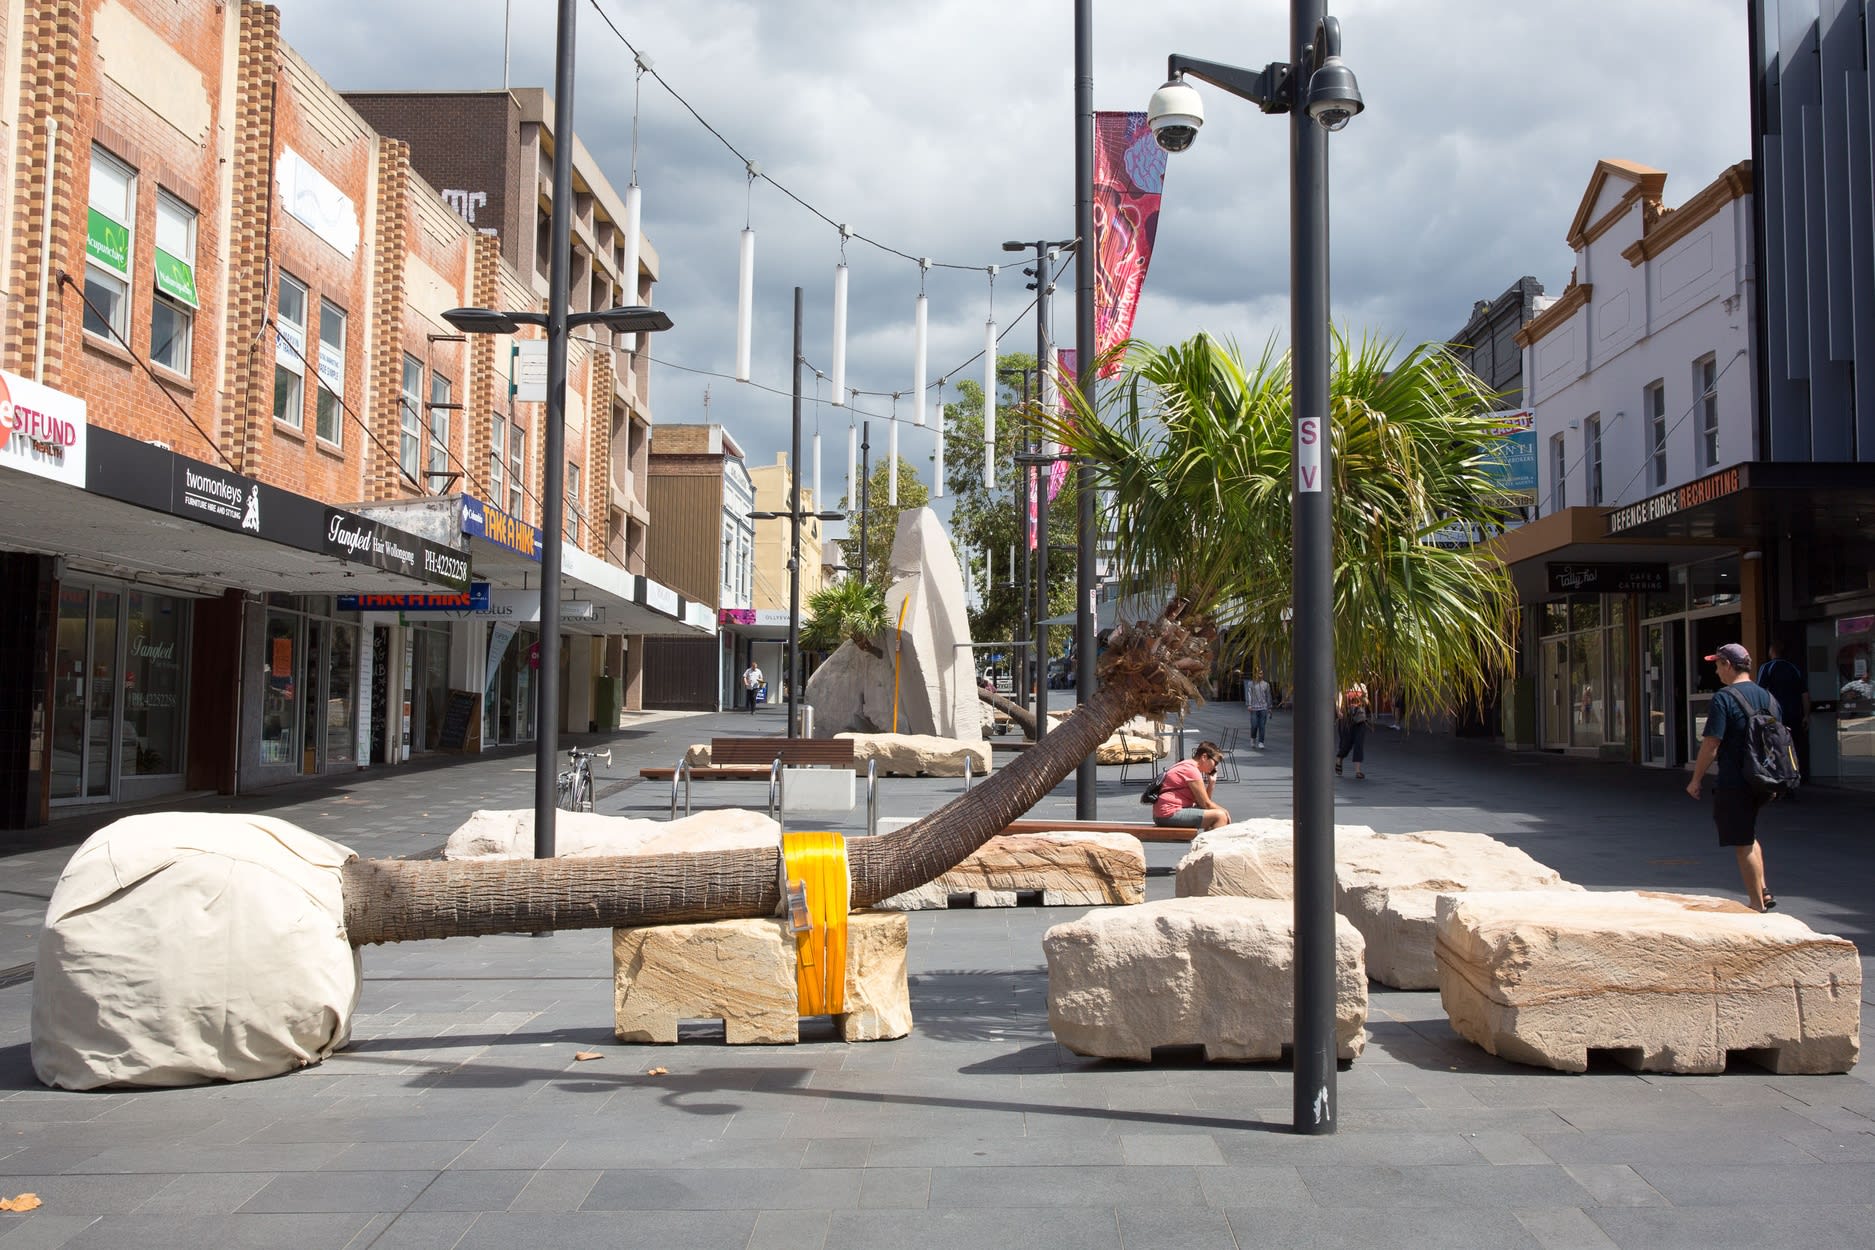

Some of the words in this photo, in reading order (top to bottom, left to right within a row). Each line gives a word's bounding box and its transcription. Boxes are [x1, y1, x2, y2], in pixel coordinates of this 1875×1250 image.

[86, 233, 125, 264] Acupuncture
[185, 496, 207, 510] FURNITURE
[207, 502, 217, 513] HIRE
[217, 506, 226, 515] AND
[225, 508, 241, 520] STYLING
[186, 468, 242, 505] twomonkeys
[1611, 502, 1647, 532] DEFENCE
[1649, 491, 1678, 520] FORCE
[1679, 469, 1739, 509] RECRUITING
[328, 514, 372, 554] Tangled
[373, 537, 384, 554] Hair
[385, 541, 415, 565] Wollongong
[483, 504, 507, 545] TAKE
[507, 518, 515, 548] A
[515, 520, 535, 556] HIKE
